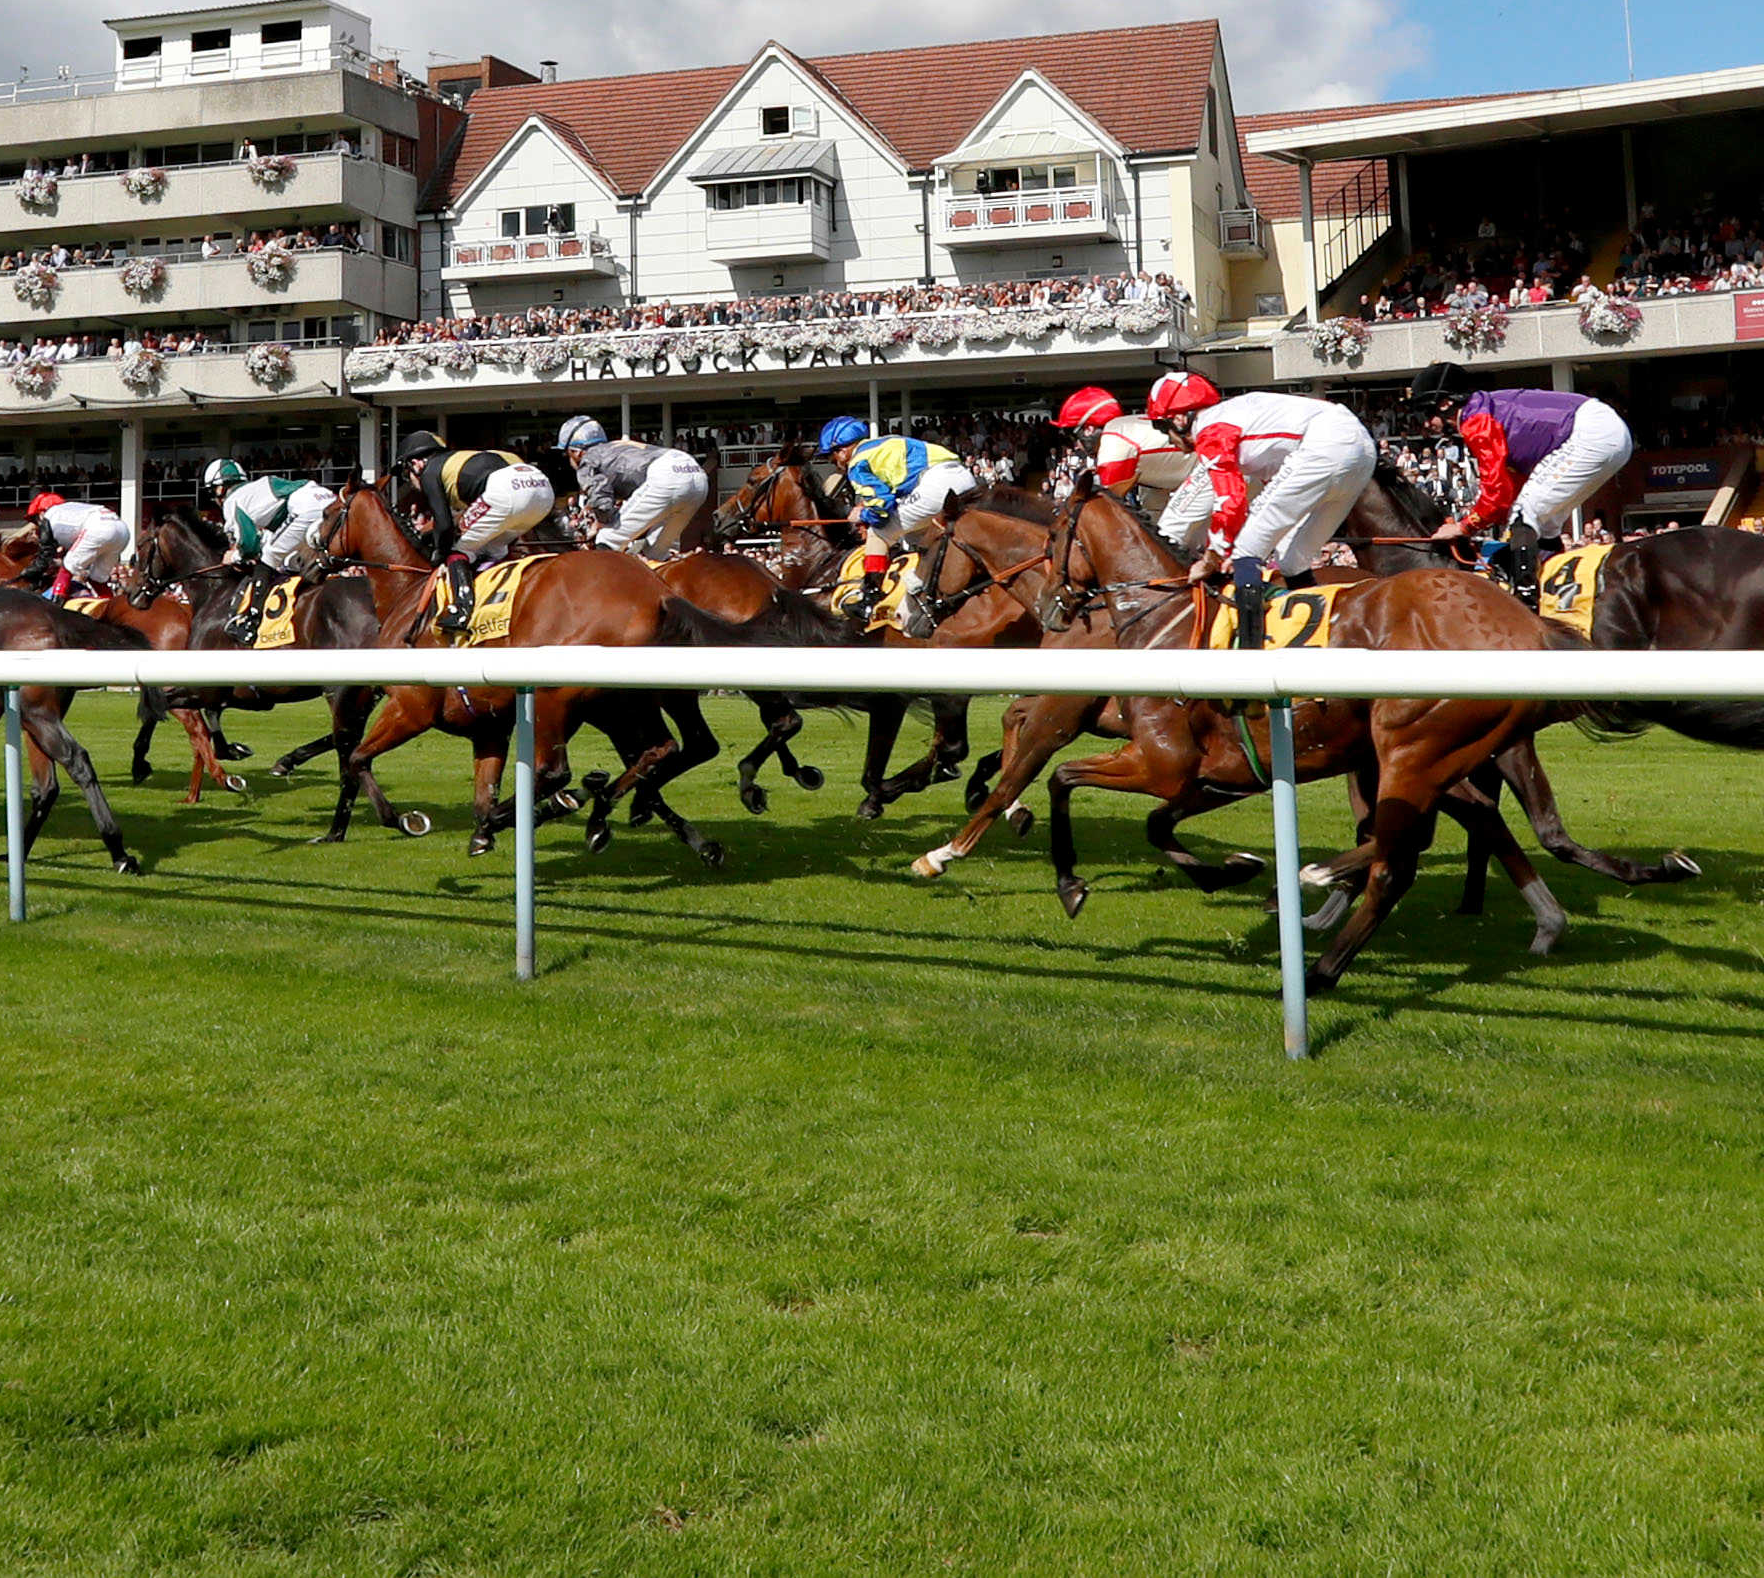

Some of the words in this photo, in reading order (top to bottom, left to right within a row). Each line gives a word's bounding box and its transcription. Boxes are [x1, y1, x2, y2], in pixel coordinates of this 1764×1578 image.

[1651, 462, 1710, 476] TOTEPOOL
[480, 562, 518, 607] 2
[1543, 556, 1583, 610] 4
